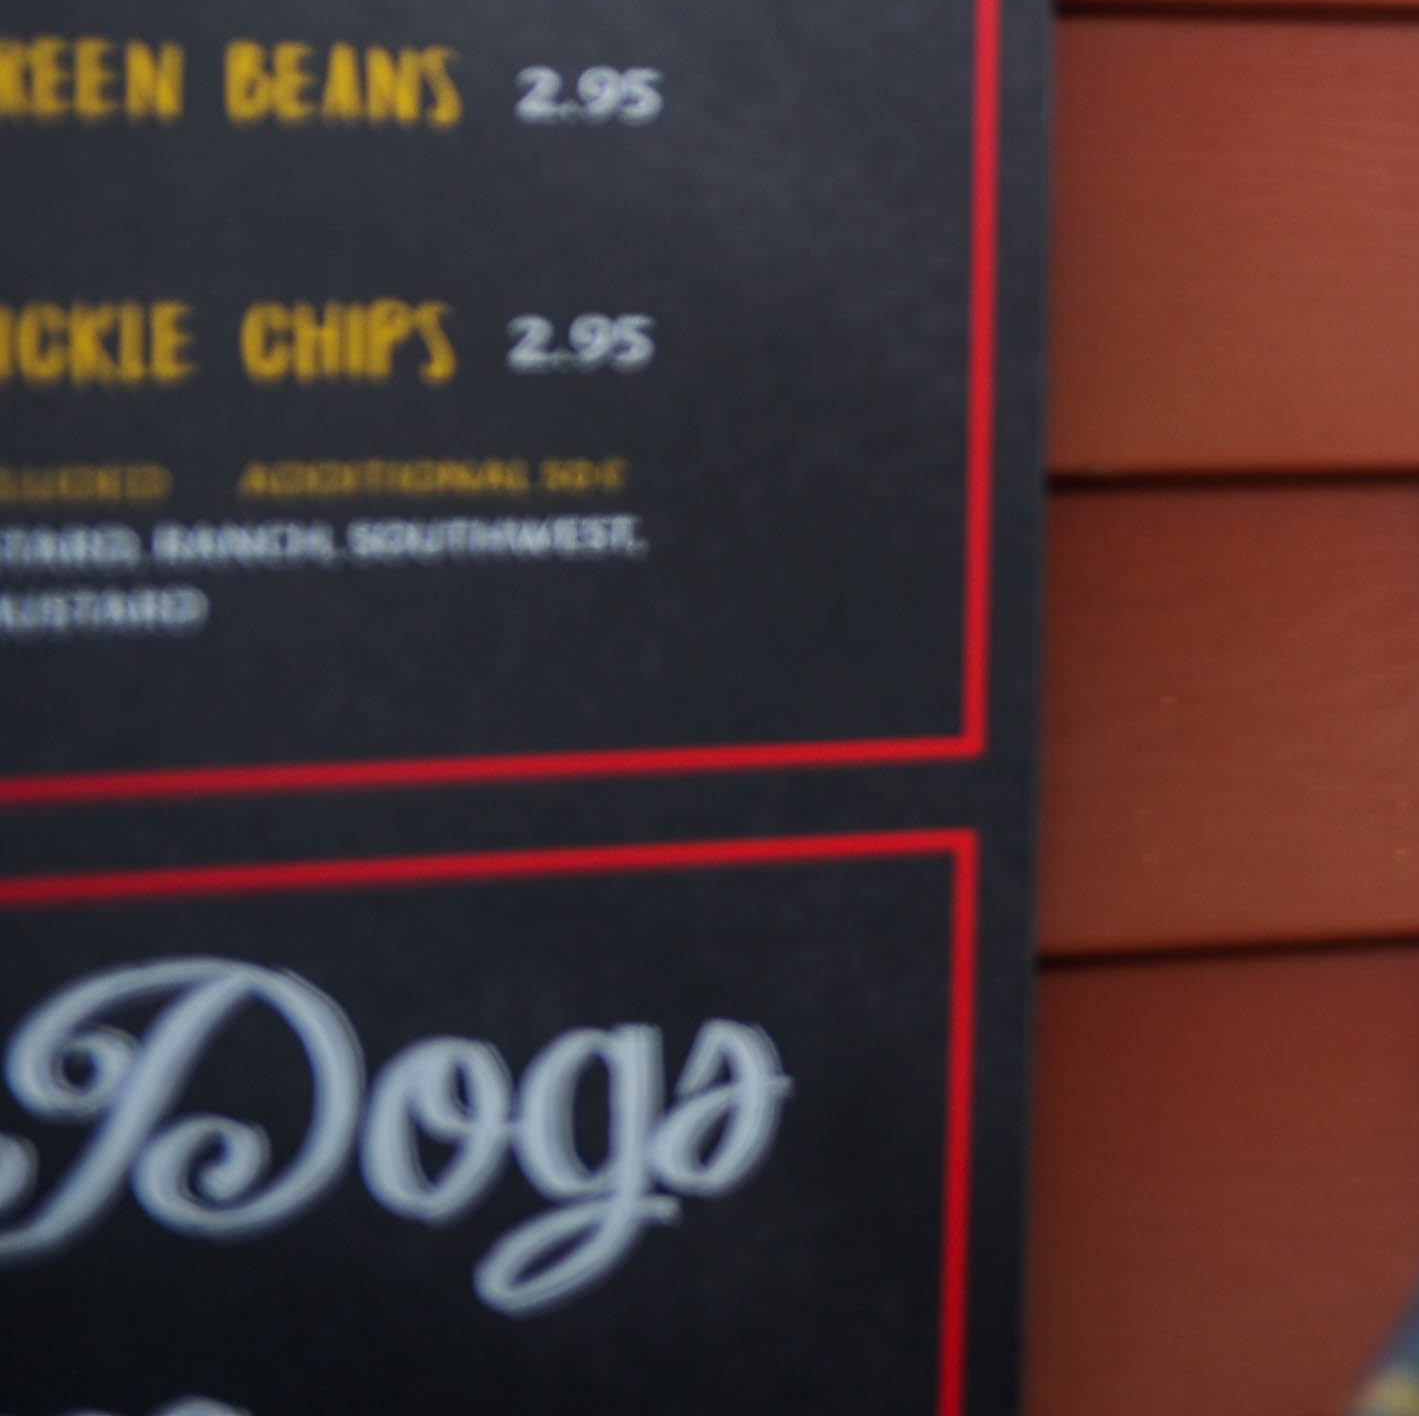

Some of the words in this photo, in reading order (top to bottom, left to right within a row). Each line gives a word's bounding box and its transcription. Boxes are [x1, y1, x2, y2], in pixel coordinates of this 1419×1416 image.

[224, 40, 462, 128] BEANS
[516, 65, 664, 123] 2.95
[240, 298, 456, 383] CHIPS
[507, 314, 655, 372] 2.95
[240, 460, 529, 498] ADDITIONAL
[0, 955, 793, 1315] Dogs
